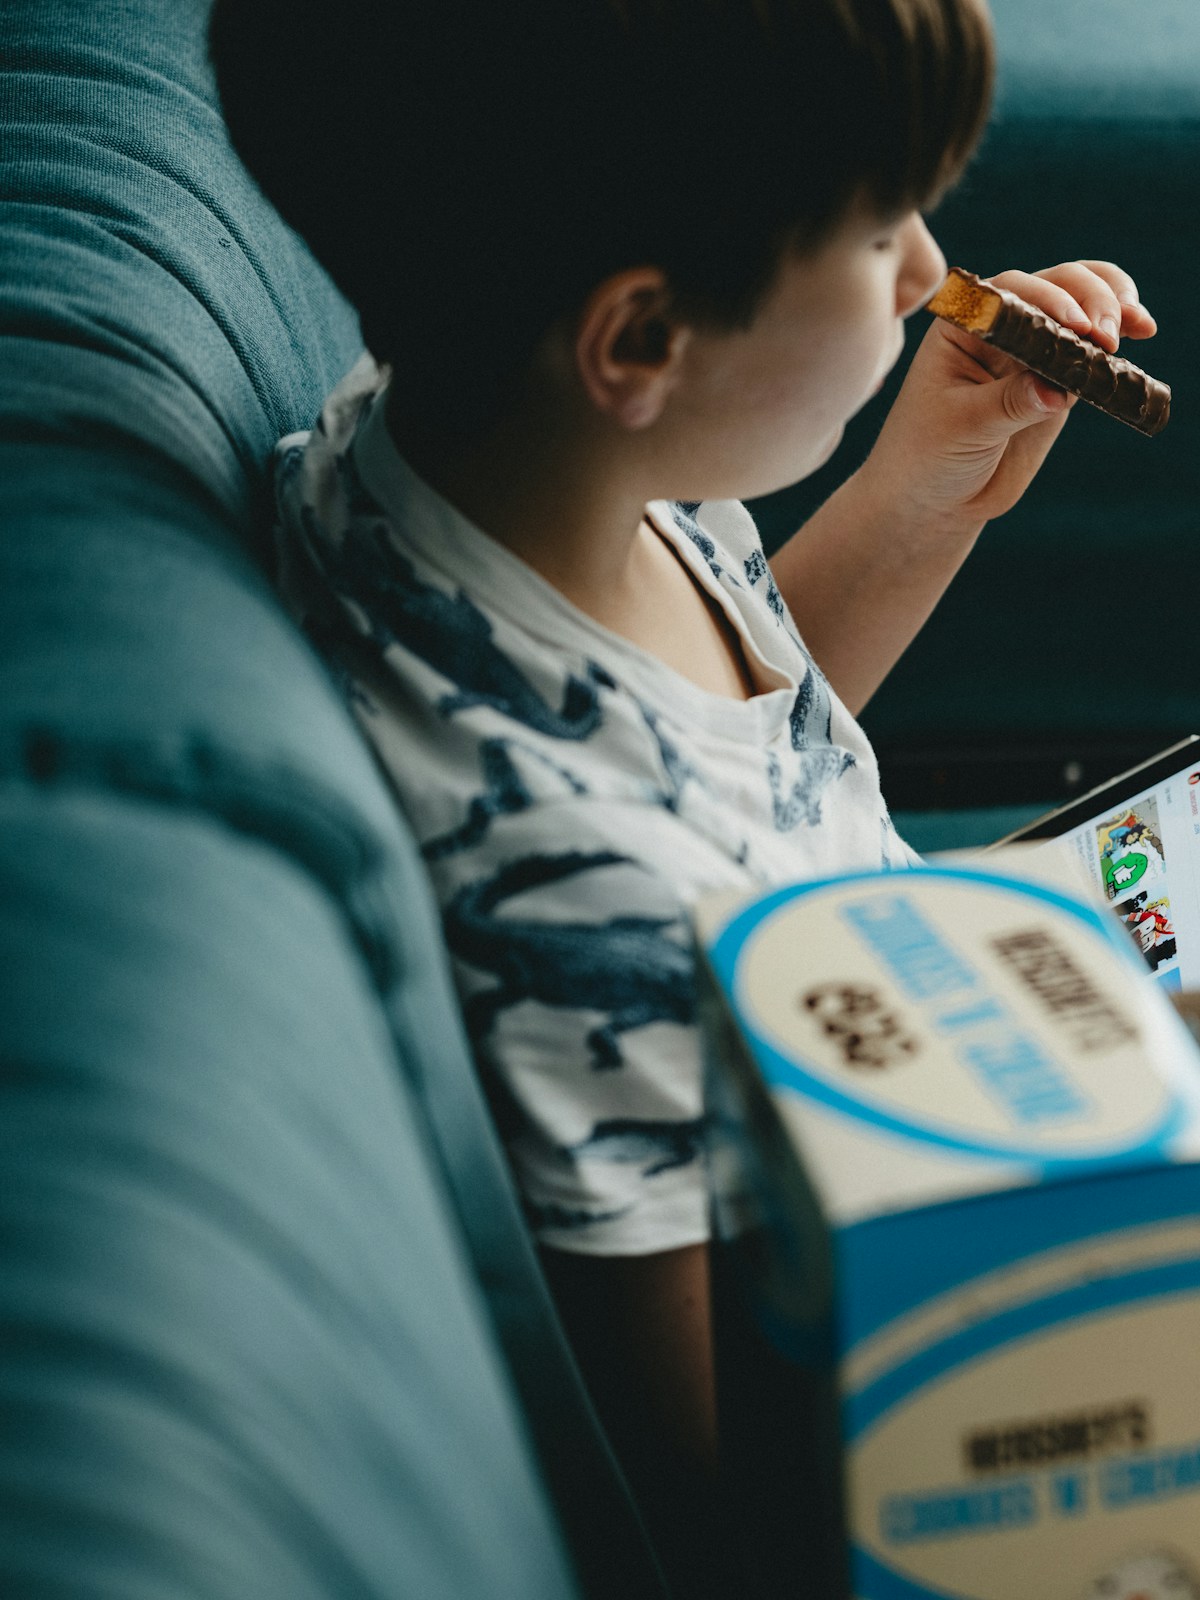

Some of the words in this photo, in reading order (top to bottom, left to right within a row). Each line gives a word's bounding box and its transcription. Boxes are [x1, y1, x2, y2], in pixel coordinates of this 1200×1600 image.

[1189, 789, 1198, 816] SUBSCRIBE
[963, 1396, 1152, 1472] HERSHEY'S
[879, 1478, 1037, 1545] COOKIES
